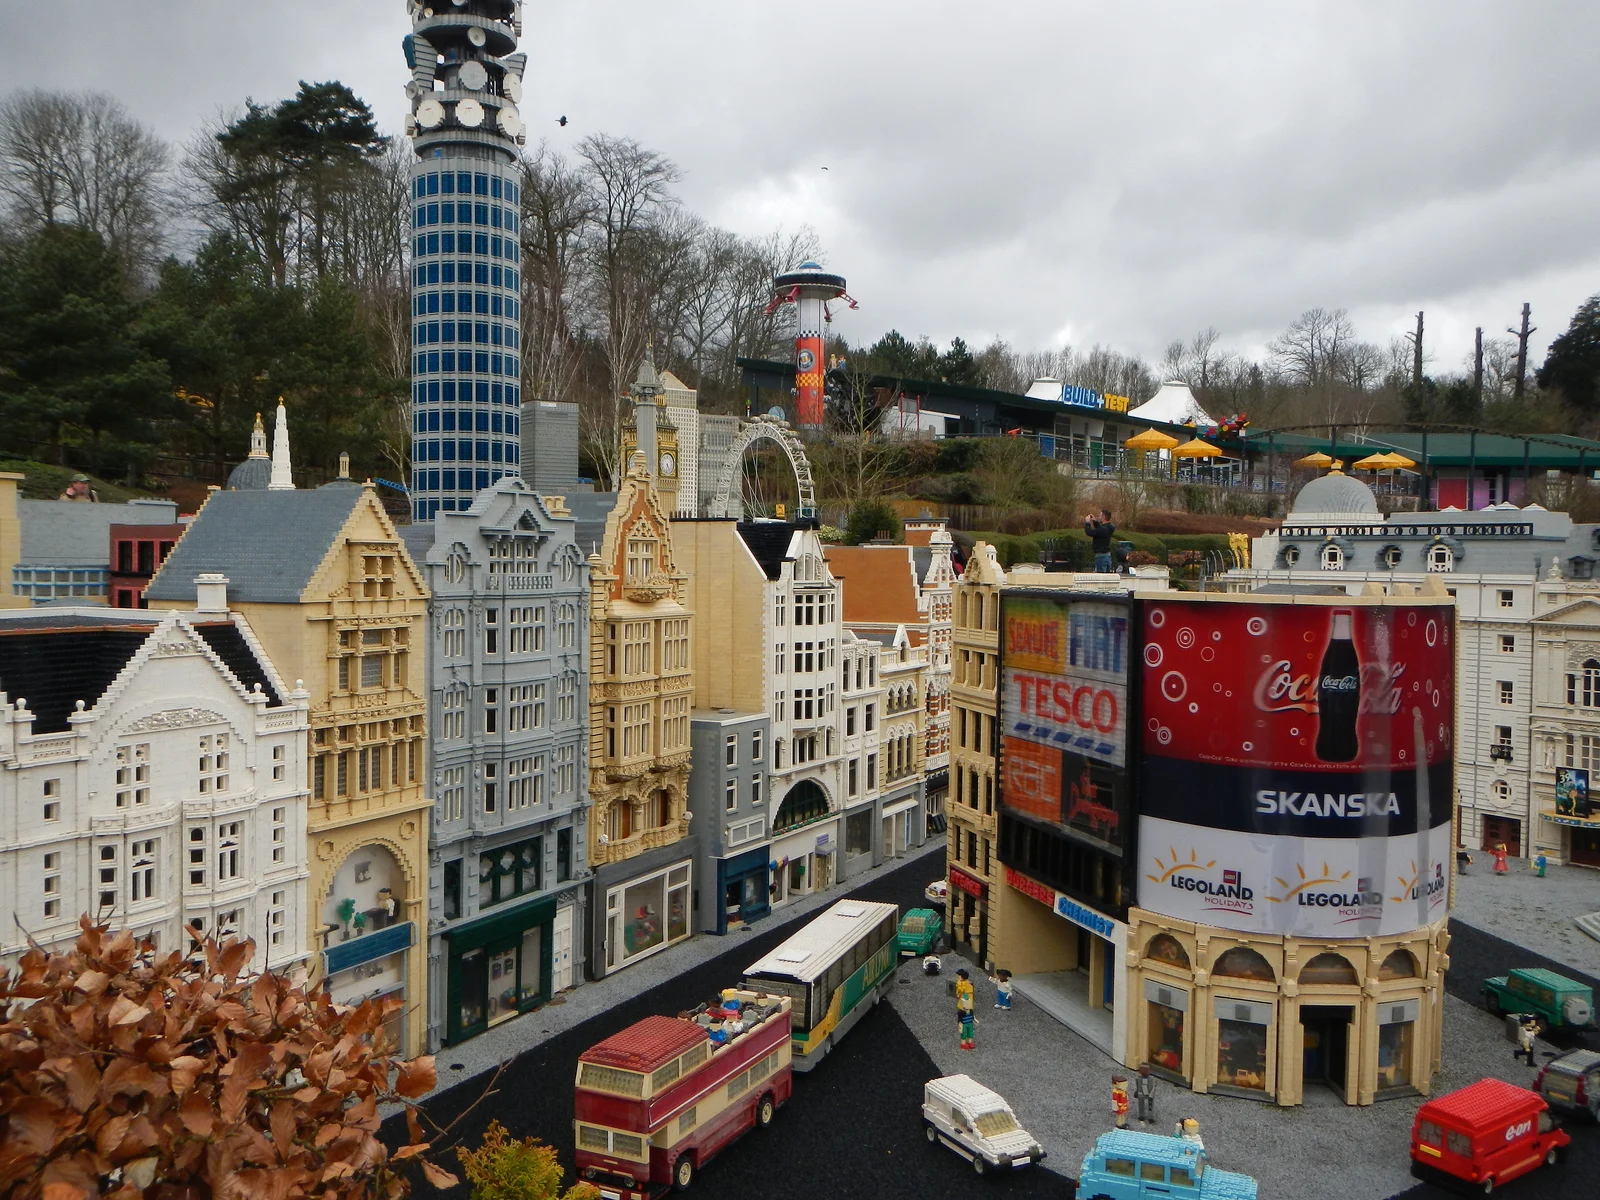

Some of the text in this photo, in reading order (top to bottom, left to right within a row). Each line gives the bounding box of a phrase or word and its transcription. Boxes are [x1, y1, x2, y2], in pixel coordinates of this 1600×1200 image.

[1062, 384, 1096, 408] BUILD
[1104, 393, 1129, 413] TEST
[1069, 613, 1127, 673] FIAT
[1013, 674, 1118, 734] TESCO
[1256, 789, 1401, 818] SKANSKA
[1171, 871, 1253, 901] LEGOLAND
[1058, 896, 1115, 937] CHEMIST
[1204, 896, 1254, 910] HOLIDAYS
